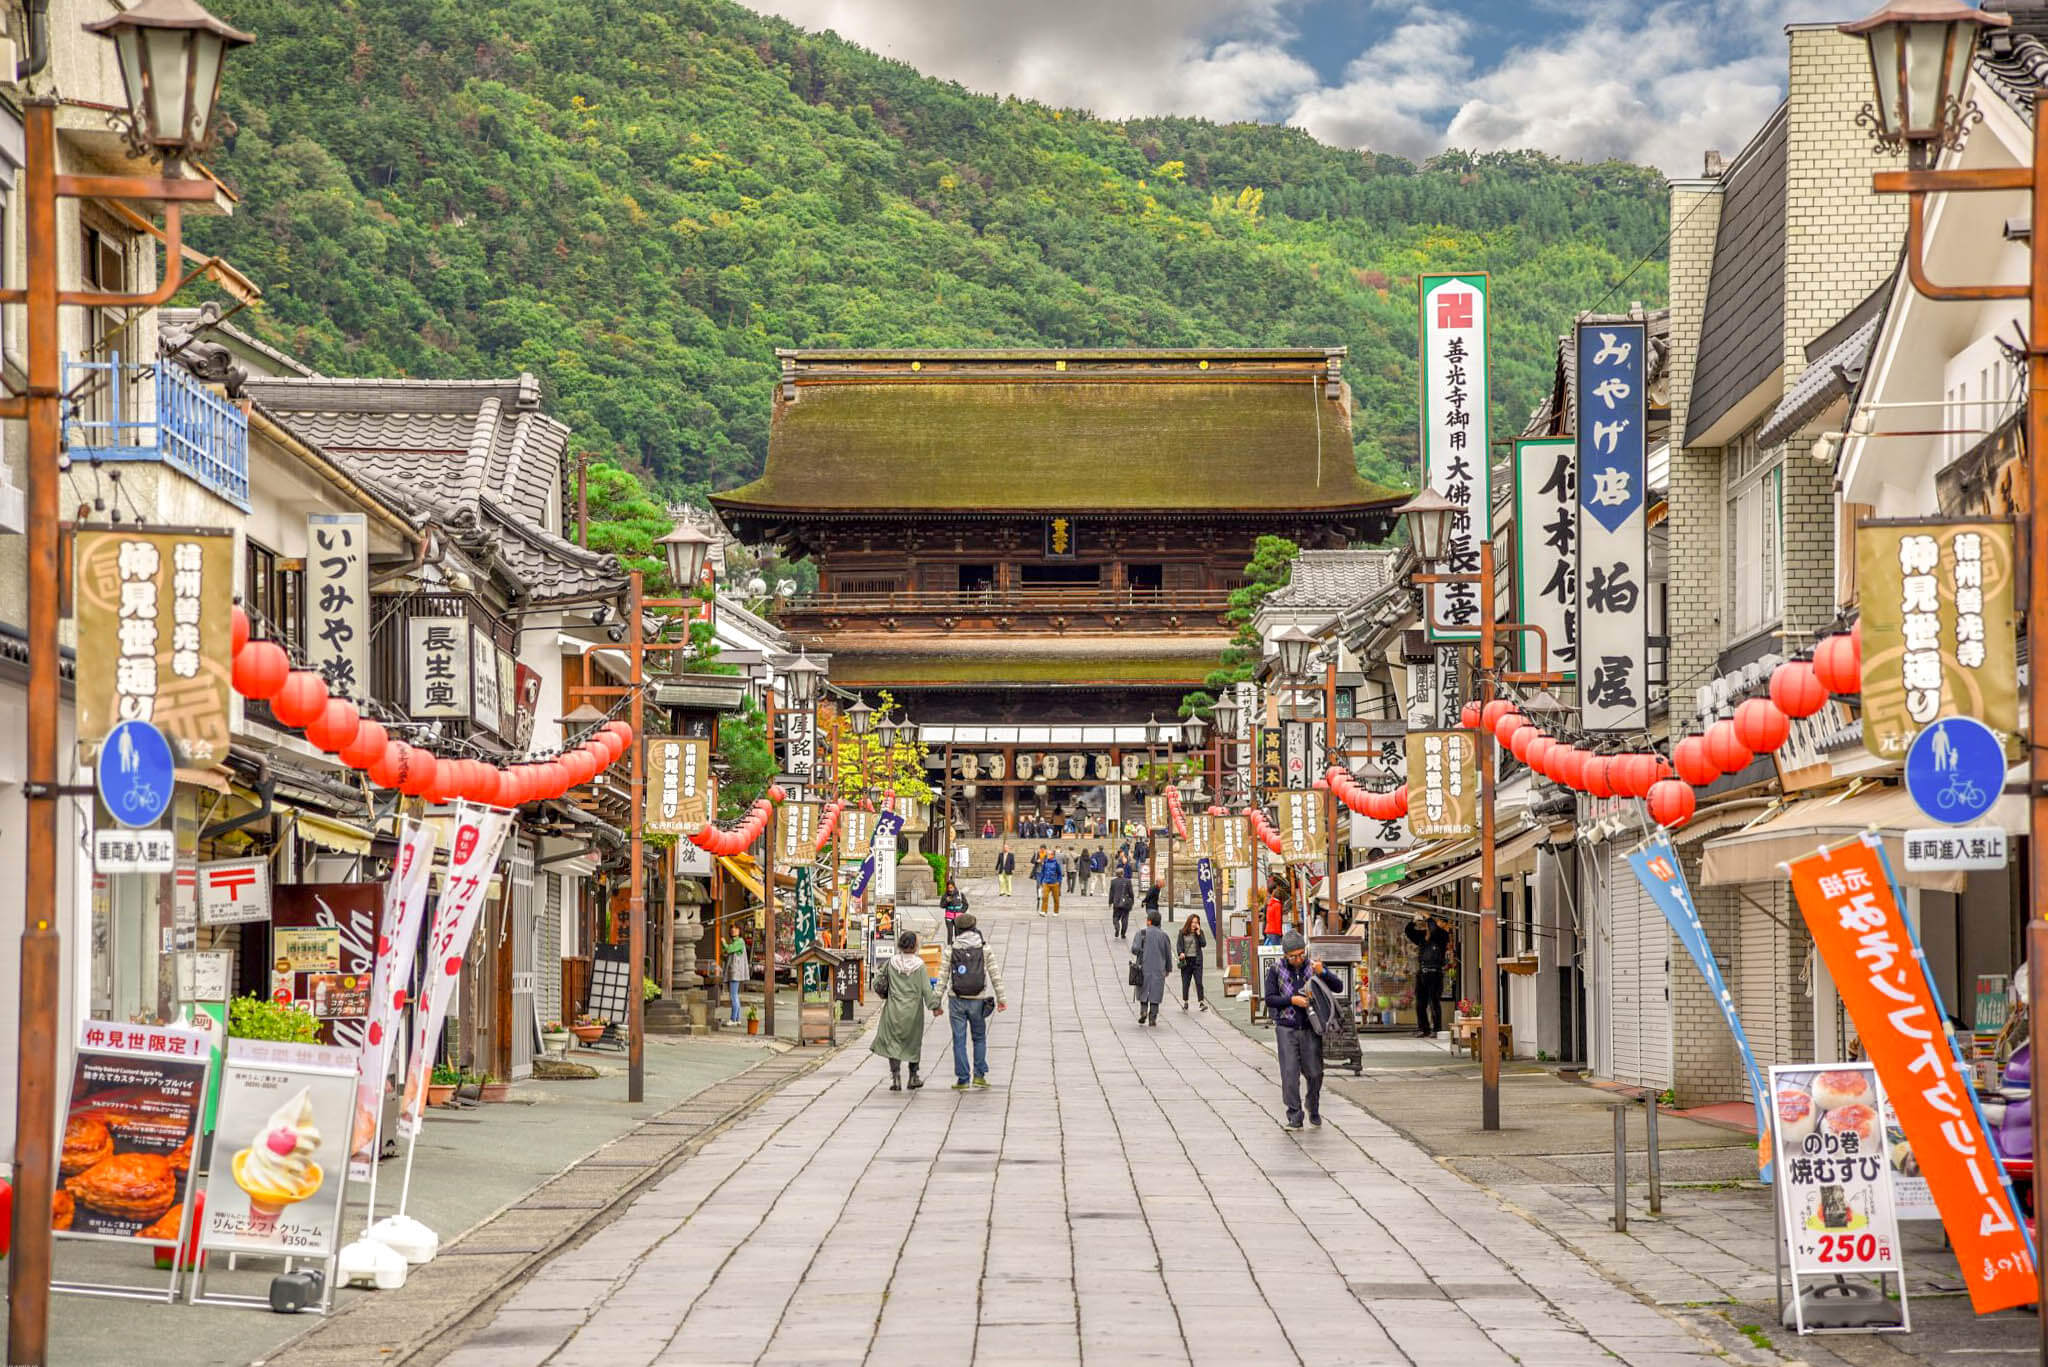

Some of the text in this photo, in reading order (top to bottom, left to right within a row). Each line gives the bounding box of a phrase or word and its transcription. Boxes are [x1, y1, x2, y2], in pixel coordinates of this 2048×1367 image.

[1443, 337, 1470, 449] 善光寺御用
[1590, 332, 1633, 506] みやげ店
[117, 541, 161, 721] 仲見世通り
[1586, 562, 1640, 709] 柏屋
[1898, 534, 1944, 724] 仲見世通り
[1952, 532, 1987, 669] 信州善光寺
[422, 625, 459, 709] 長生堂
[99, 840, 171, 863] 車両進入禁止
[1907, 838, 2003, 862] 車両進入禁止
[1790, 1155, 1881, 1185] 焼むすび
[1803, 1131, 1860, 1155] のり巻
[213, 1218, 322, 1237] りんごソフトクリーム
[282, 1235, 307, 1246] ¥350
